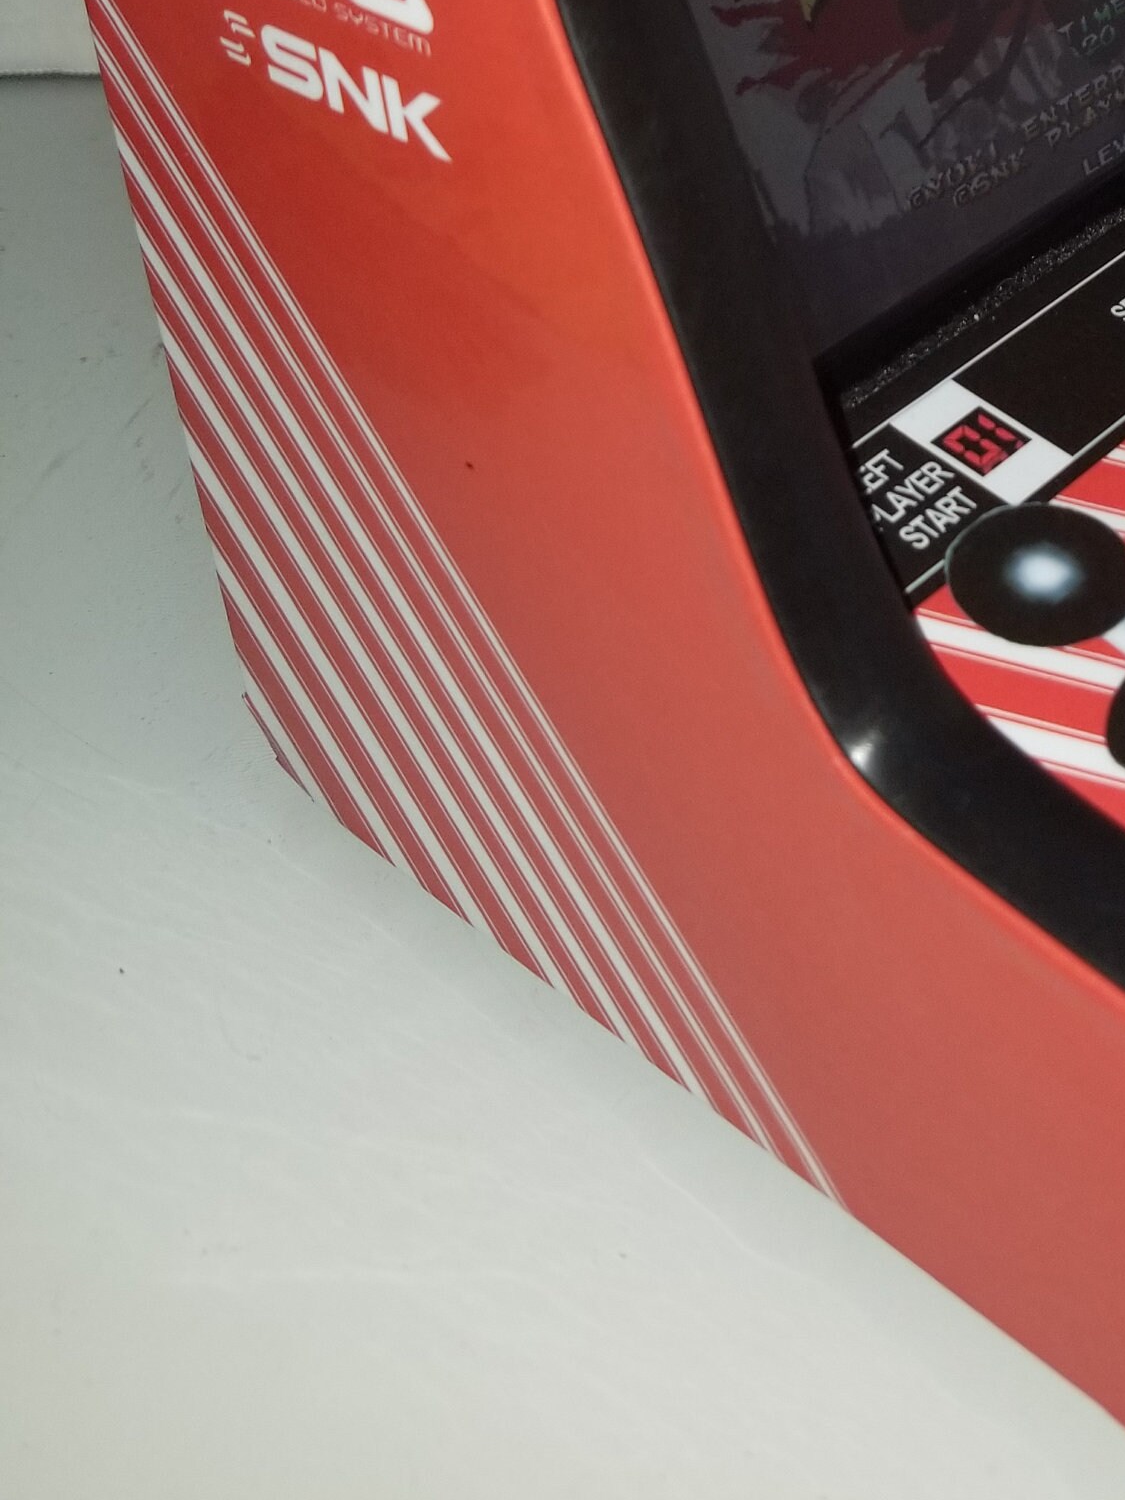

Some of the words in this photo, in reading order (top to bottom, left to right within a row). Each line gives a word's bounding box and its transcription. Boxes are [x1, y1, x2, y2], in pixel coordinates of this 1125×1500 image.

[333, 1, 432, 58] SYSTEM
[260, 23, 453, 165] SNK
[859, 448, 905, 495] EFT
[871, 460, 956, 526] LAYER
[898, 485, 978, 550] START
